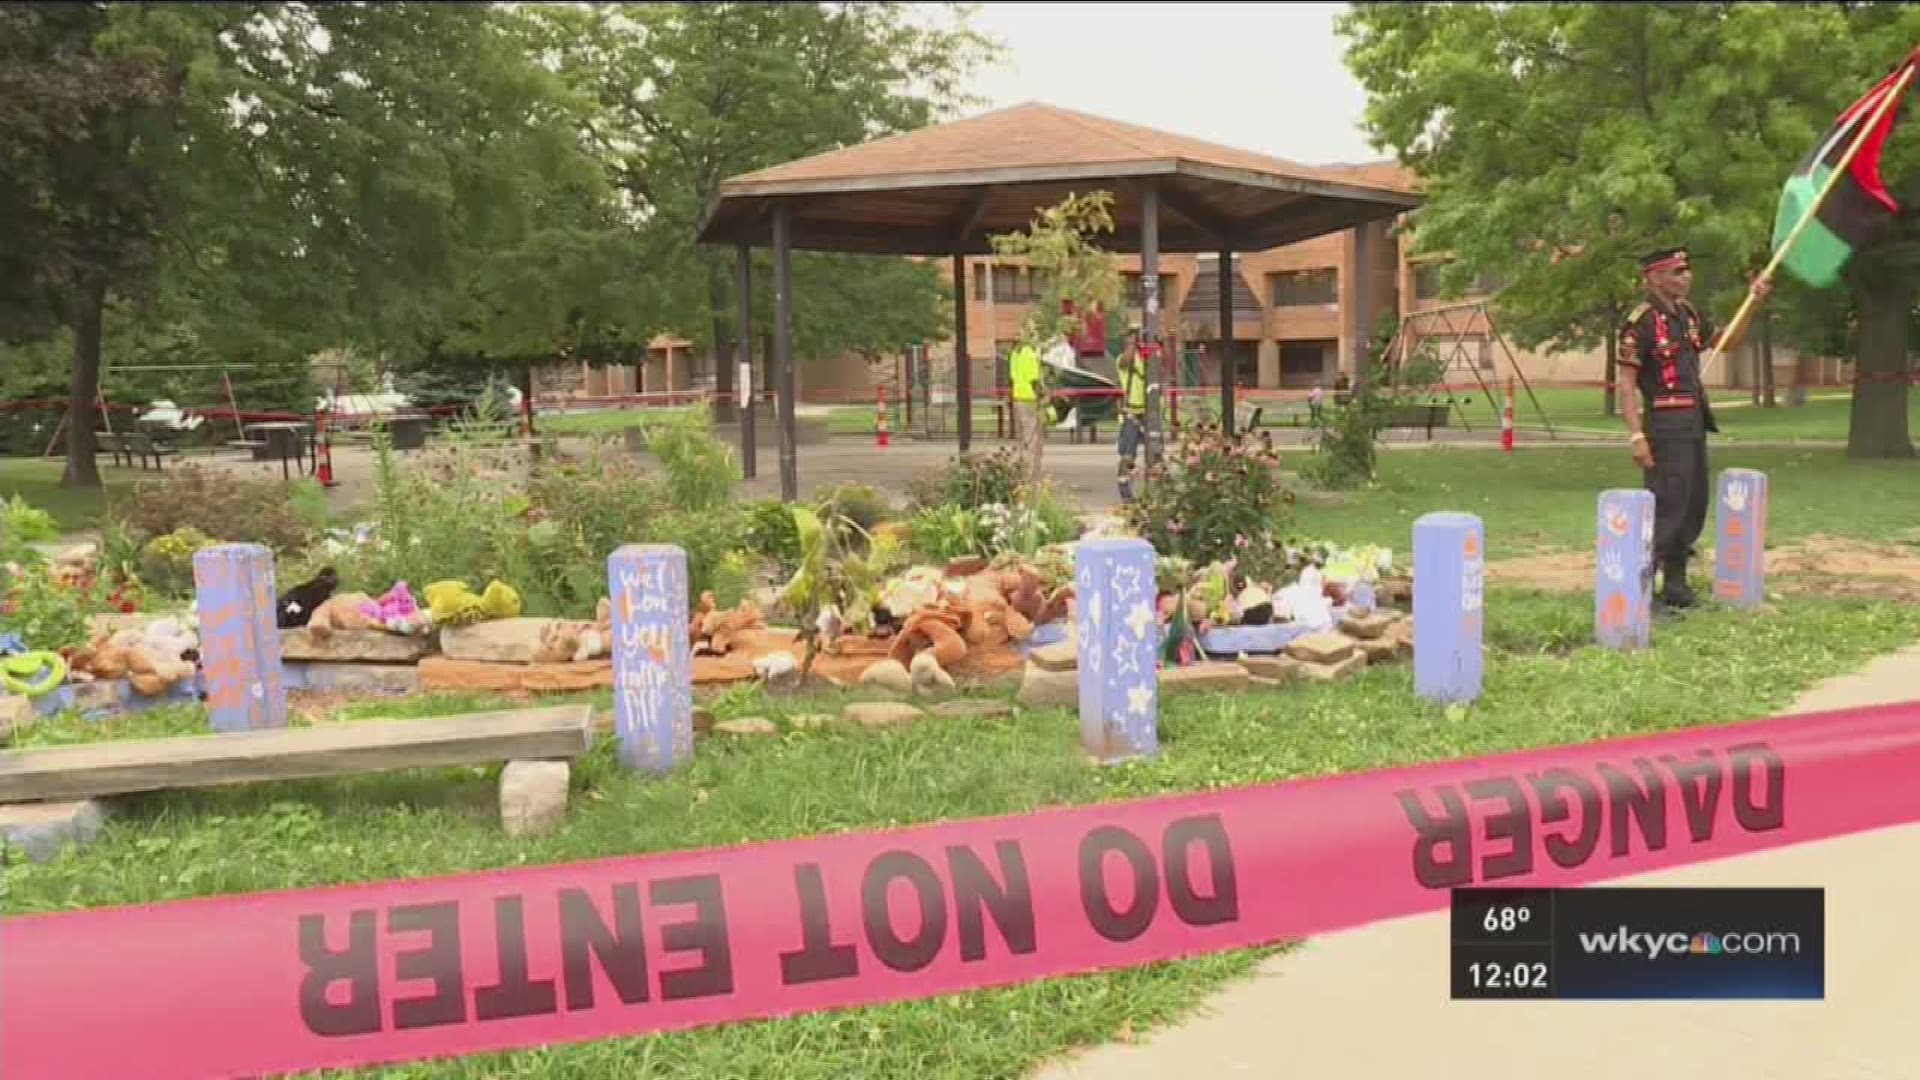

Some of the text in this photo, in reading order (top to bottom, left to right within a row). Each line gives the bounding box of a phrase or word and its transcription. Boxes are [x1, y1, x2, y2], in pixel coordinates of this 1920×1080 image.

[296, 743, 1786, 1039] DANGER DO NOT ENTER
